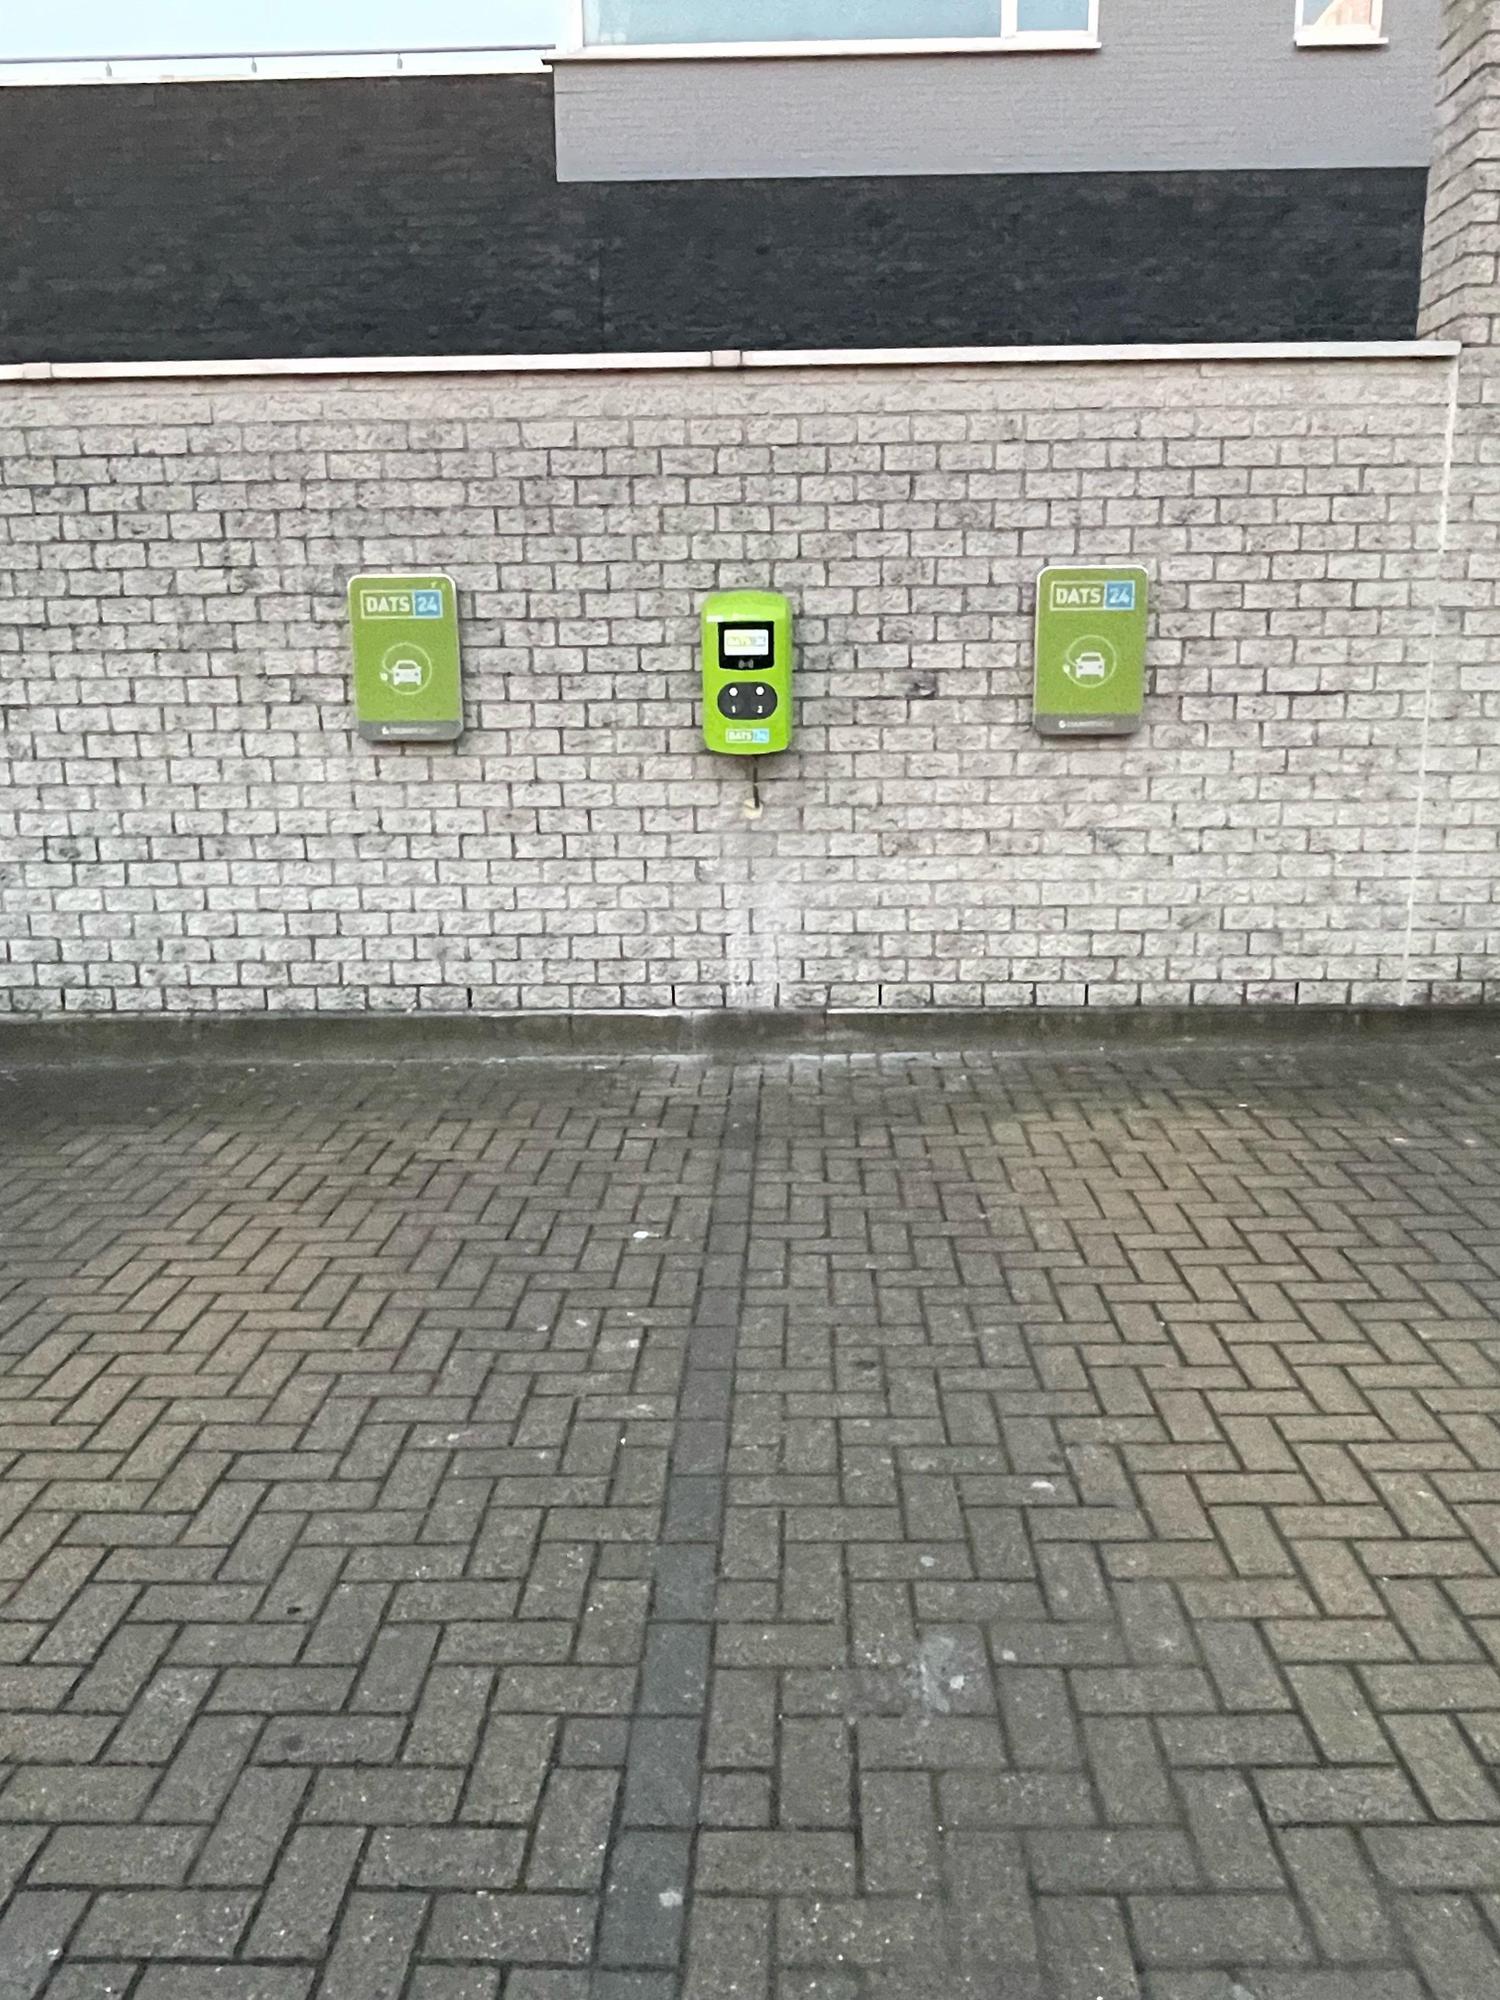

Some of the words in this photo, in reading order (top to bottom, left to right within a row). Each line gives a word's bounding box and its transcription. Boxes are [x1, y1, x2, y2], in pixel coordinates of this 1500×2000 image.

[1056, 587, 1102, 605] DATS
[1109, 587, 1131, 604] 24
[366, 597, 410, 612] DATS
[418, 597, 438, 612] 24
